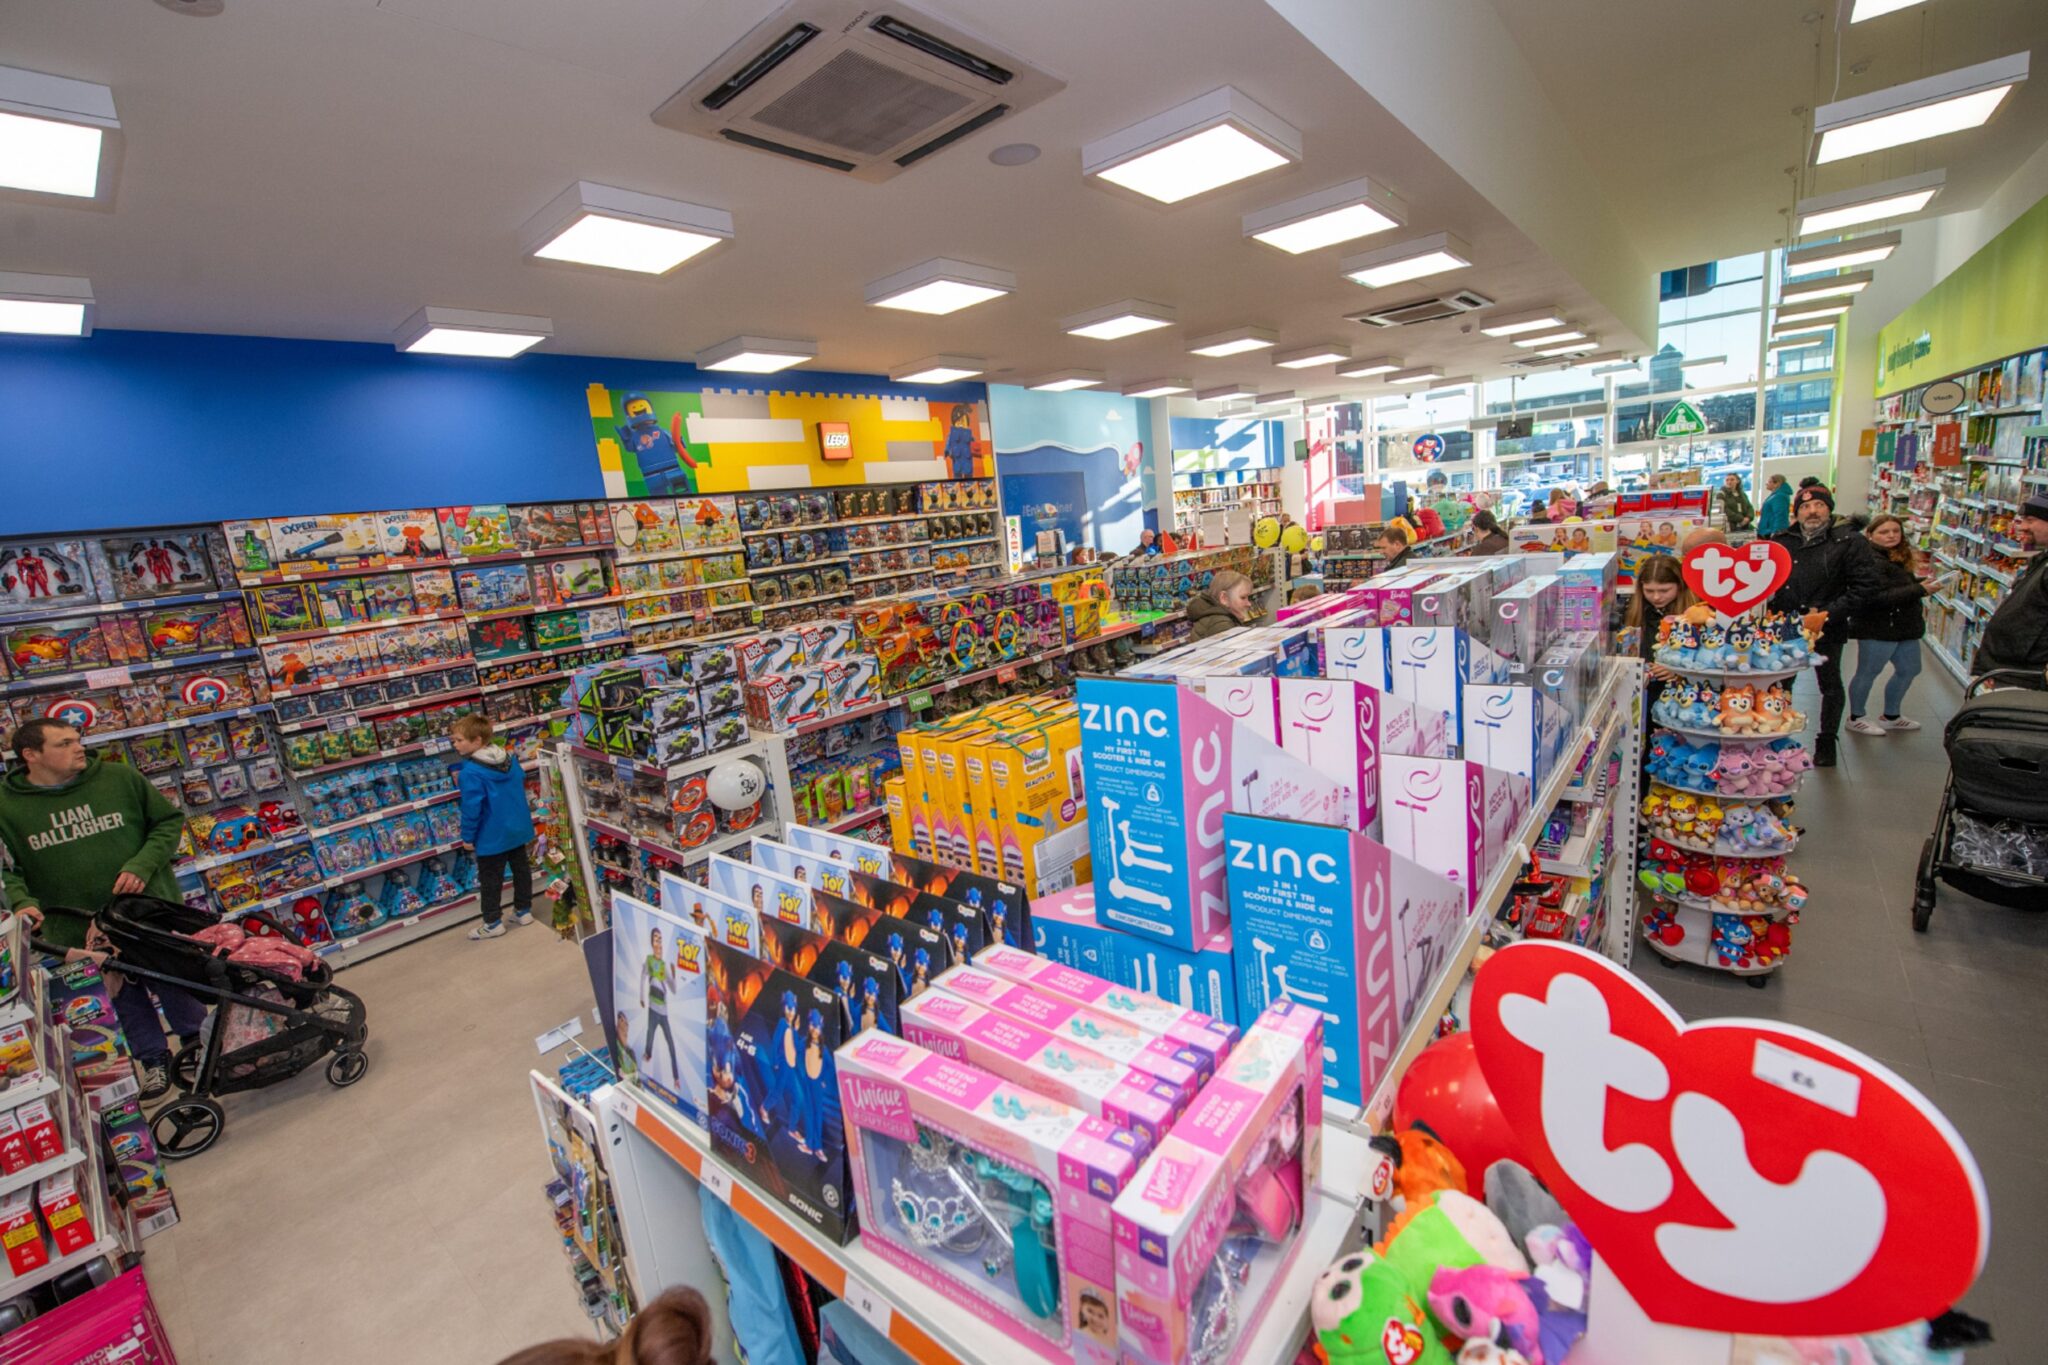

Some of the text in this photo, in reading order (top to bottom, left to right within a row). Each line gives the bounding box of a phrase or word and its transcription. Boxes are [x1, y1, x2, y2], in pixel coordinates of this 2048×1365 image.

[826, 433, 848, 447] LEGO
[1690, 547, 1777, 603] ty
[1390, 590, 1408, 600] Barbie
[912, 694, 928, 705] NEW
[1081, 702, 1168, 738] ZINC
[1104, 745, 1151, 757] MY FIRST TRI
[1116, 738, 1121, 746] 3
[1093, 752, 1125, 763] SCOOTER
[1135, 757, 1152, 767] RIDE
[1153, 760, 1166, 768] ON
[1358, 695, 1379, 810] EVO
[1094, 763, 1166, 780] PRODUCT DIMENSIONS
[50, 804, 95, 829] LIAM
[28, 812, 125, 851] GALLAGHER
[1192, 730, 1229, 934] ZINC
[857, 856, 882, 876] TOY
[1230, 839, 1337, 884] ZINC
[821, 872, 846, 892] TOY
[1281, 882, 1291, 890] IN
[778, 893, 803, 914] TOY
[1243, 890, 1334, 915] SCOOTER & RIDE ON
[1258, 886, 1315, 903] MY FIRST TRI
[780, 911, 799, 921] STORY
[1245, 902, 1333, 928] PRODUCT DIMENSIONS
[726, 917, 750, 937] TOY
[676, 939, 701, 961] TOY
[728, 936, 748, 947] STORY
[678, 959, 698, 971] STORY
[1057, 976, 1068, 984] TO
[1068, 979, 1078, 988] BE
[1061, 970, 1093, 986] PRETEND
[1363, 868, 1390, 1086] ZINC
[1019, 1000, 1031, 1008] TO
[1032, 1003, 1041, 1013] BE
[1024, 994, 1057, 1010] PRETEND
[992, 1027, 1004, 1036] TO
[1004, 1032, 1013, 1041] BE
[997, 1021, 1031, 1039] PRETEND
[1153, 1040, 1169, 1052] 3+
[935, 1071, 948, 1081] TO
[949, 1075, 960, 1085] BE
[938, 1064, 979, 1083] PRETEND
[1130, 1074, 1147, 1086] 3+
[845, 1077, 903, 1116] Unique
[1192, 1093, 1221, 1128] PRETEND
[1205, 1116, 1217, 1128] TO
[1214, 1108, 1223, 1118] BE
[852, 1111, 911, 1137] BOUTIQUE
[1086, 1119, 1104, 1132] 3+
[1498, 972, 1888, 1305] ty
[744, 1142, 757, 1164] 3
[1063, 1162, 1081, 1180] 3+
[787, 1193, 824, 1224] SONIC
[1181, 1171, 1228, 1274] Unique
[1117, 1224, 1133, 1241] 3+
[907, 1262, 920, 1276] TO
[921, 1270, 934, 1284] BE
[1387, 1327, 1416, 1365] ty
